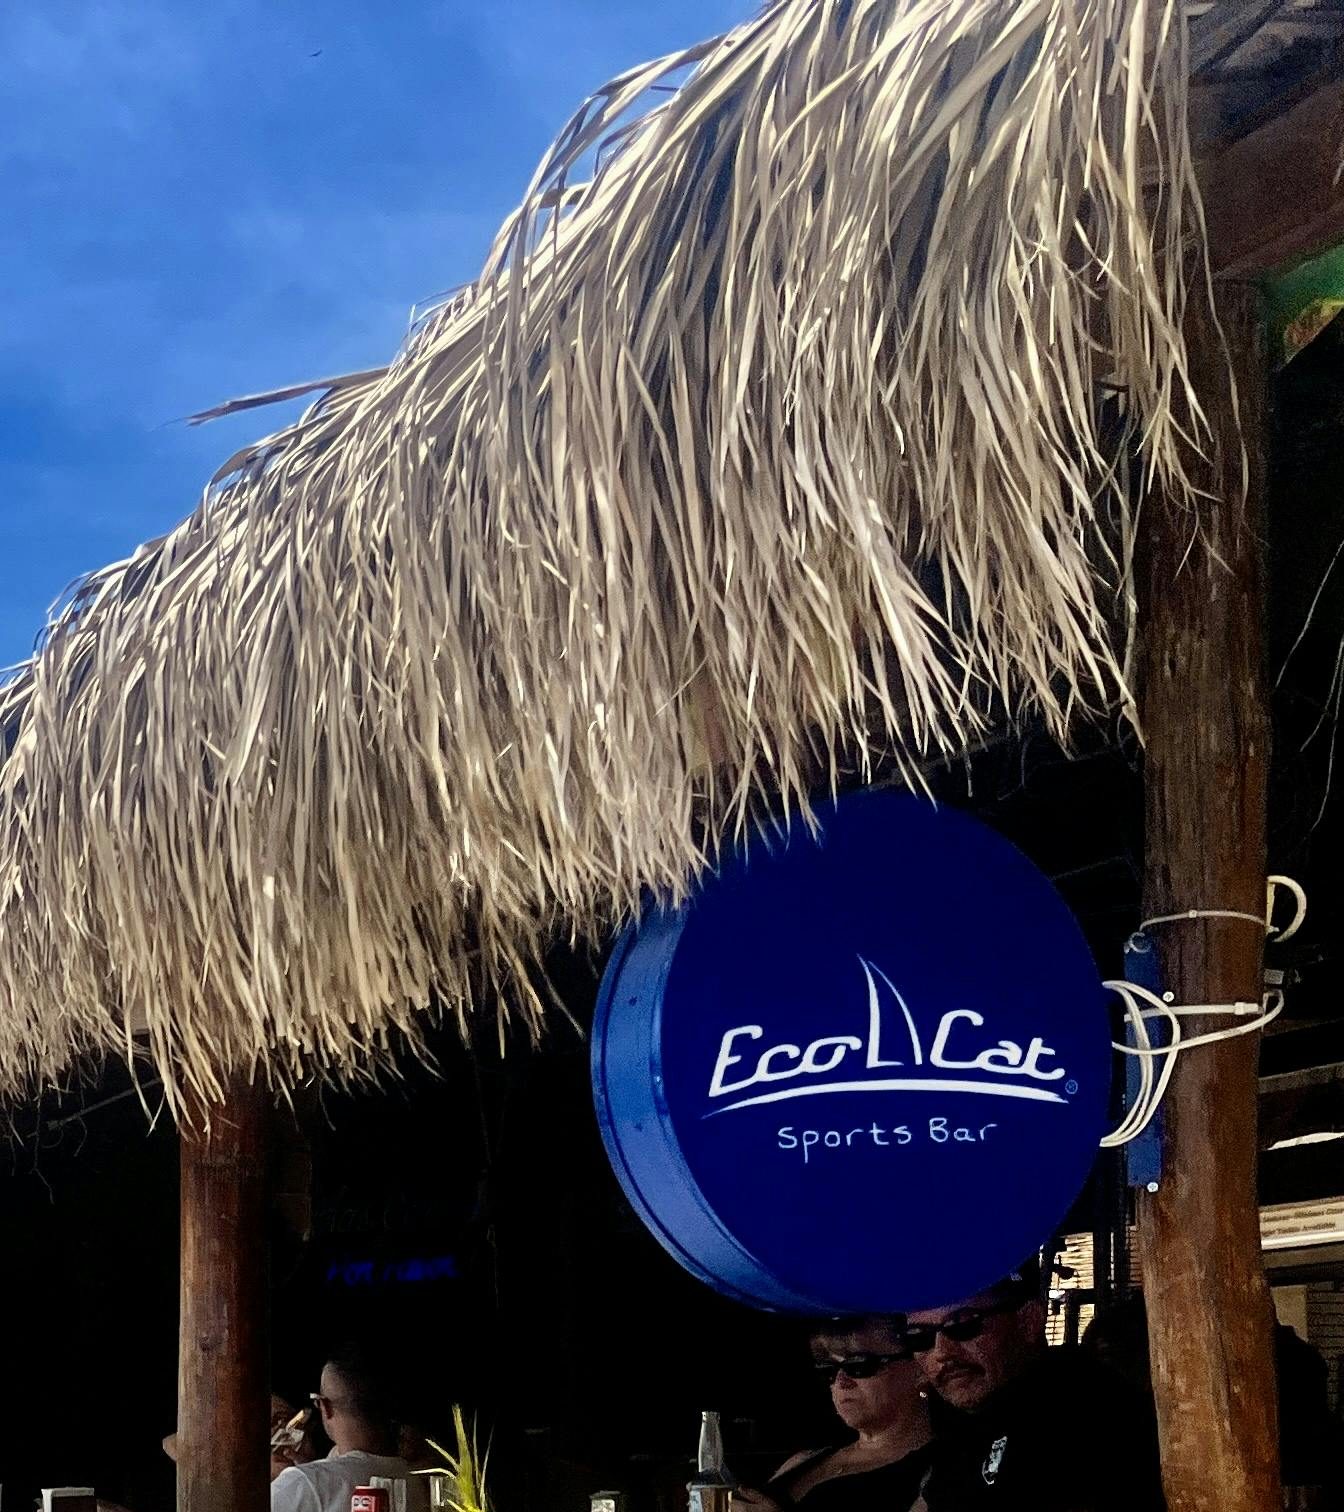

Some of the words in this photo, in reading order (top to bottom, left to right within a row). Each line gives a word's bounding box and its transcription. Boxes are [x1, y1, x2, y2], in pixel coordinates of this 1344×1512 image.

[708, 1024, 863, 1098] Eco
[929, 1009, 1067, 1081] Cat
[929, 1116, 998, 1143] Bar
